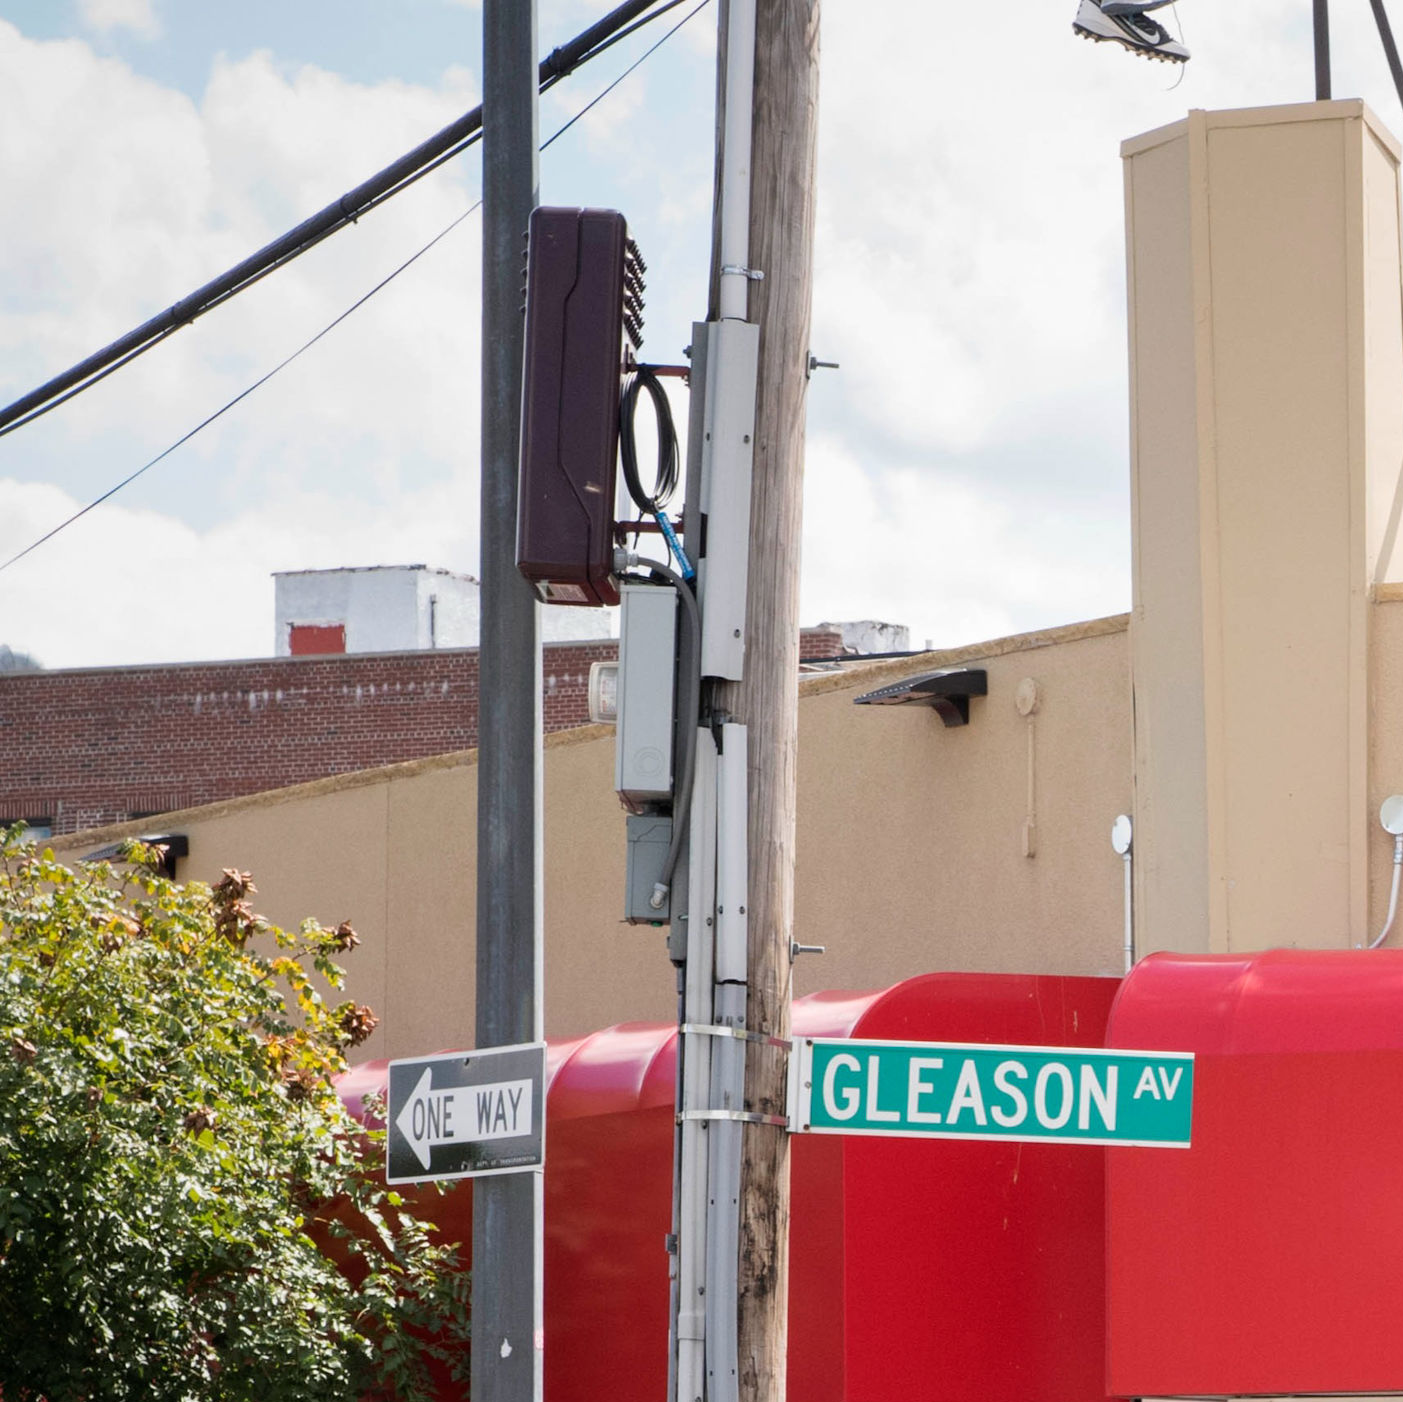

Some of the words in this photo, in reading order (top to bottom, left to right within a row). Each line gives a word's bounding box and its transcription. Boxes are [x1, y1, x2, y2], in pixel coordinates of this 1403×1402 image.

[413, 1095, 454, 1141] ONE
[477, 1087, 523, 1135] WAY
[822, 1053, 1118, 1131] GLEASON
[1133, 1066, 1183, 1101] AV
